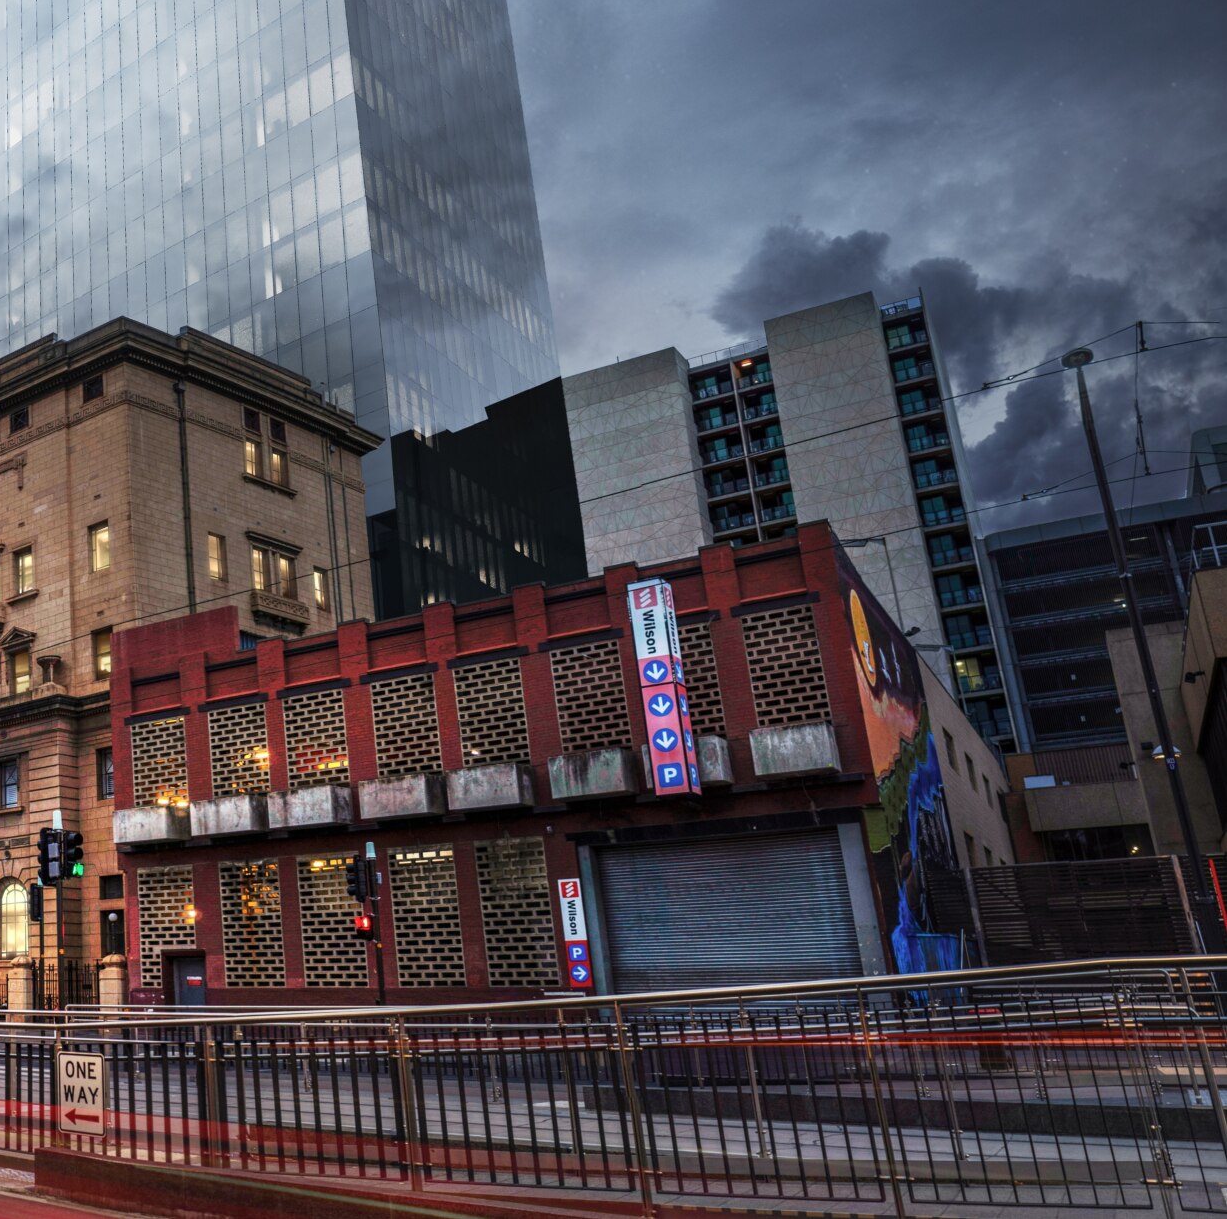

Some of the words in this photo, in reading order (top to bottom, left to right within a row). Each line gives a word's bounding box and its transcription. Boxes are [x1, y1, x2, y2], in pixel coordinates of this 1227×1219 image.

[642, 609, 657, 655] Wilson
[668, 611, 678, 654] Wilson
[664, 767, 677, 783] P
[691, 767, 696, 782] P
[567, 899, 578, 935] Wilson
[572, 947, 582, 958] P
[65, 1060, 97, 1080] ONE
[63, 1084, 99, 1105] WAY
